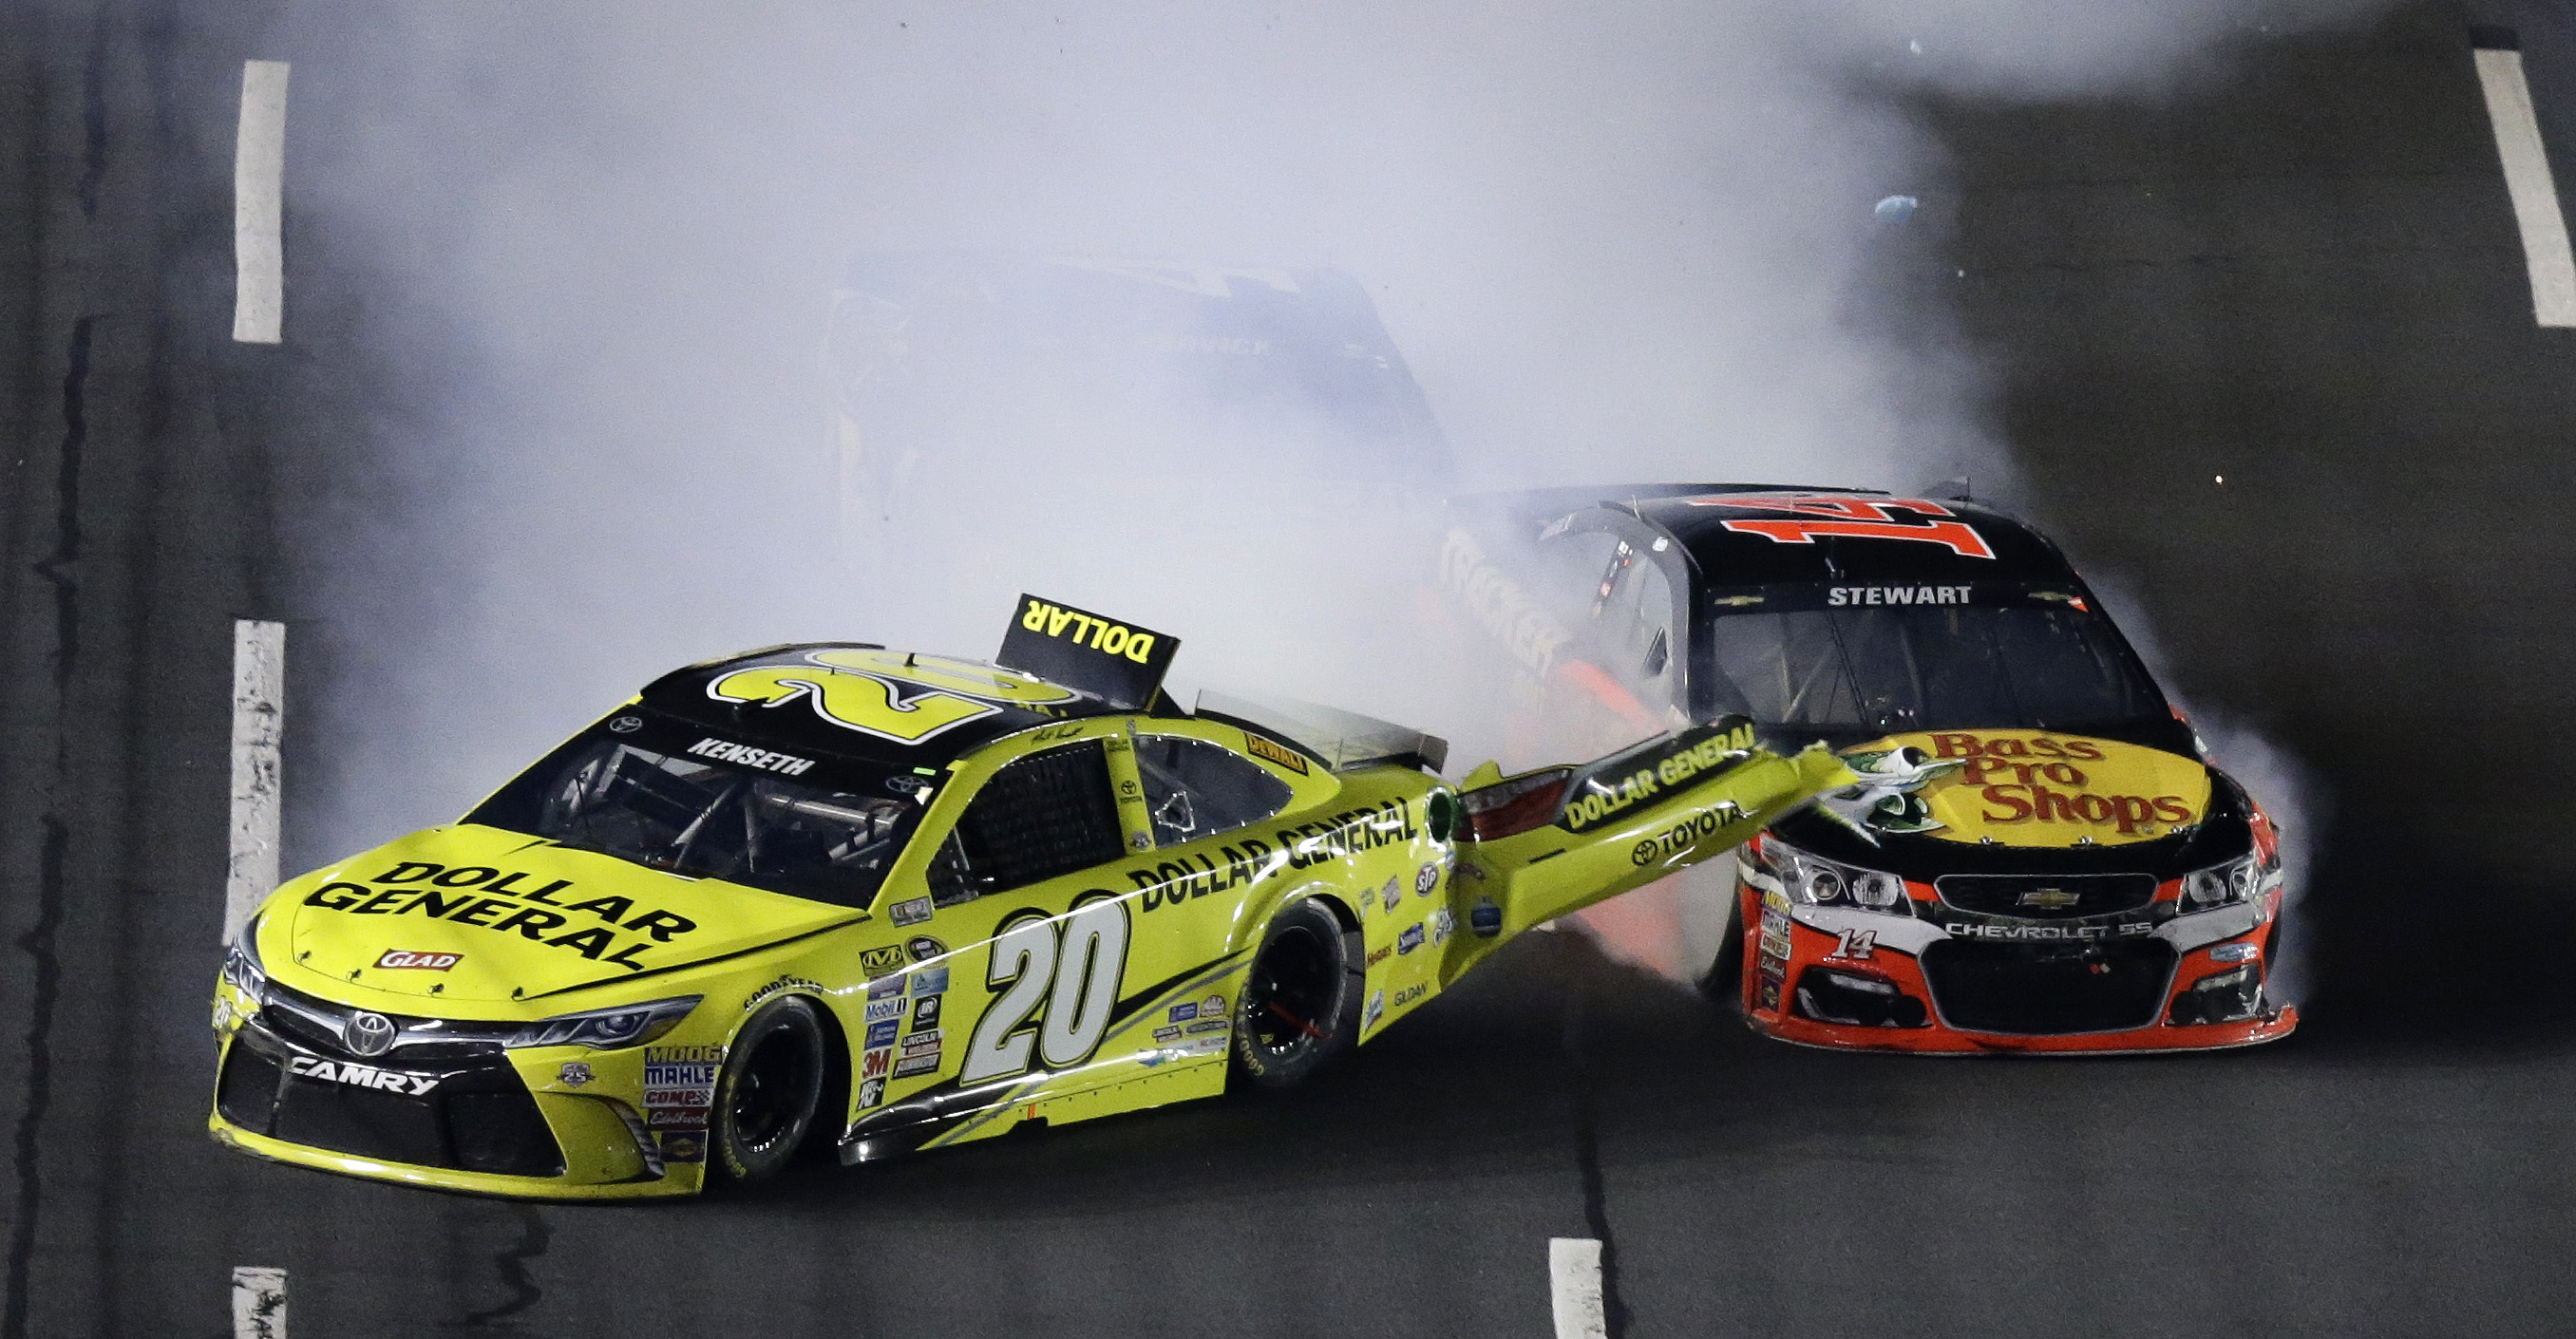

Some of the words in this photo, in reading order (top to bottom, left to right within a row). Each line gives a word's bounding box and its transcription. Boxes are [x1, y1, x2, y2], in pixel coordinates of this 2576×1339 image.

[1687, 496, 1997, 560] 14
[1828, 585, 1972, 606] STEWART
[1022, 600, 1156, 664] DOLLAR
[706, 650, 1083, 745] 20
[686, 737, 816, 777] KENSETH
[1930, 732, 2104, 761] Bass
[1960, 757, 2089, 786] Pro
[1564, 769, 1660, 829] DOLLAR
[1981, 783, 2191, 834] Shops
[1657, 800, 1746, 854] TOYOTA
[1127, 839, 1279, 913] DOLLAR
[1276, 796, 1418, 870] GENERAL
[370, 861, 698, 942] DOLLAR
[303, 881, 655, 971] GENERAL
[1830, 928, 1878, 959] 14
[1945, 923, 2110, 939] CHEVROLET
[2118, 922, 2153, 935] SS
[380, 950, 457, 970] GLAD
[959, 889, 1132, 1086] 20
[647, 1046, 722, 1063] MOOG
[862, 1048, 892, 1080] 3M
[290, 1056, 441, 1096] CAMRY
[645, 1066, 715, 1084] MAHLE
